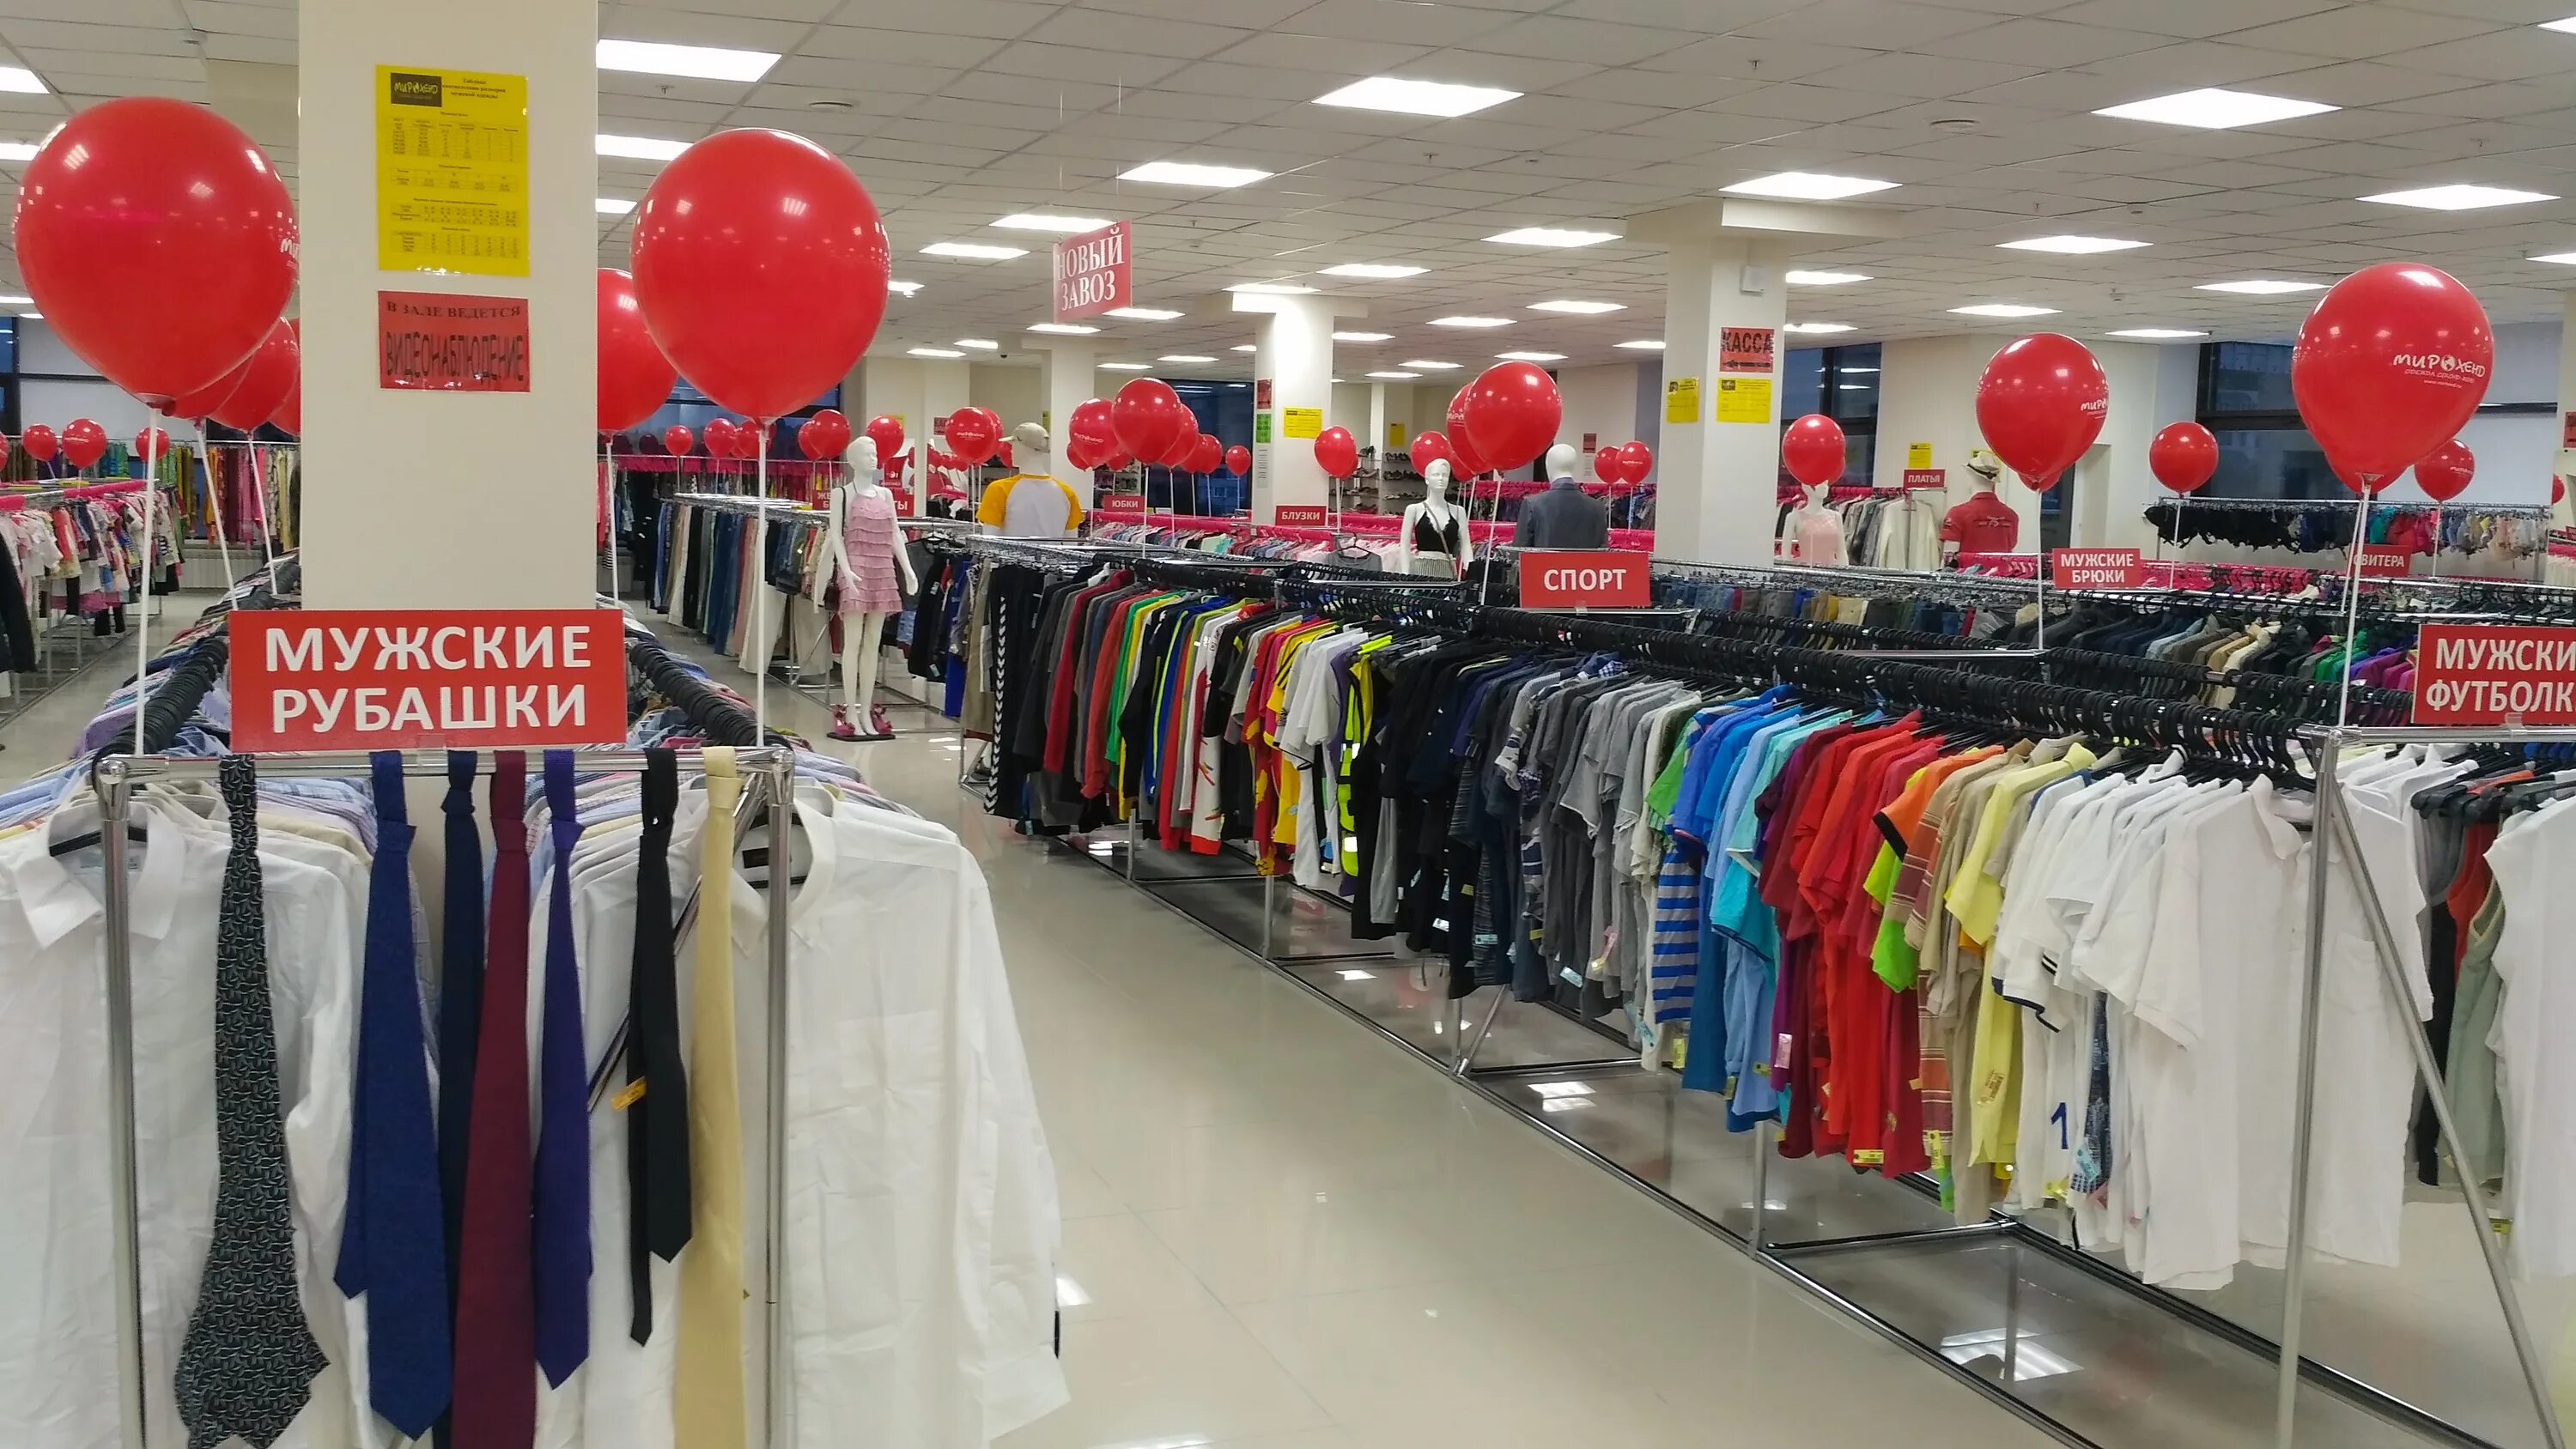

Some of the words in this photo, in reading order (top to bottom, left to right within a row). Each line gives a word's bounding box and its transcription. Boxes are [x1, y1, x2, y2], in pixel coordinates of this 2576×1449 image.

[1055, 226, 1125, 281] НОВЫЙ
[1061, 270, 1115, 311] ЗАВОЗ
[387, 301, 397, 312] В
[403, 304, 442, 317] ЗАЛЕ
[447, 306, 520, 319] ВЕДЕТСЯ
[386, 331, 523, 385] ВИДЕОНАБЛЮДЕНИЕ
[1721, 332, 1774, 354] КАССА
[1281, 512, 1321, 520] БЛУЗКИ
[2061, 554, 2134, 567] МУЖСКИЕ
[2071, 570, 2125, 583] БРЮКИ
[1544, 568, 1626, 591] СПОРТ
[265, 625, 592, 672] МУЖСКИЕ
[2435, 638, 2576, 671] МУЖСКИ
[272, 683, 586, 733] РУБАШКИ
[2050, 1102, 2069, 1149] 1
